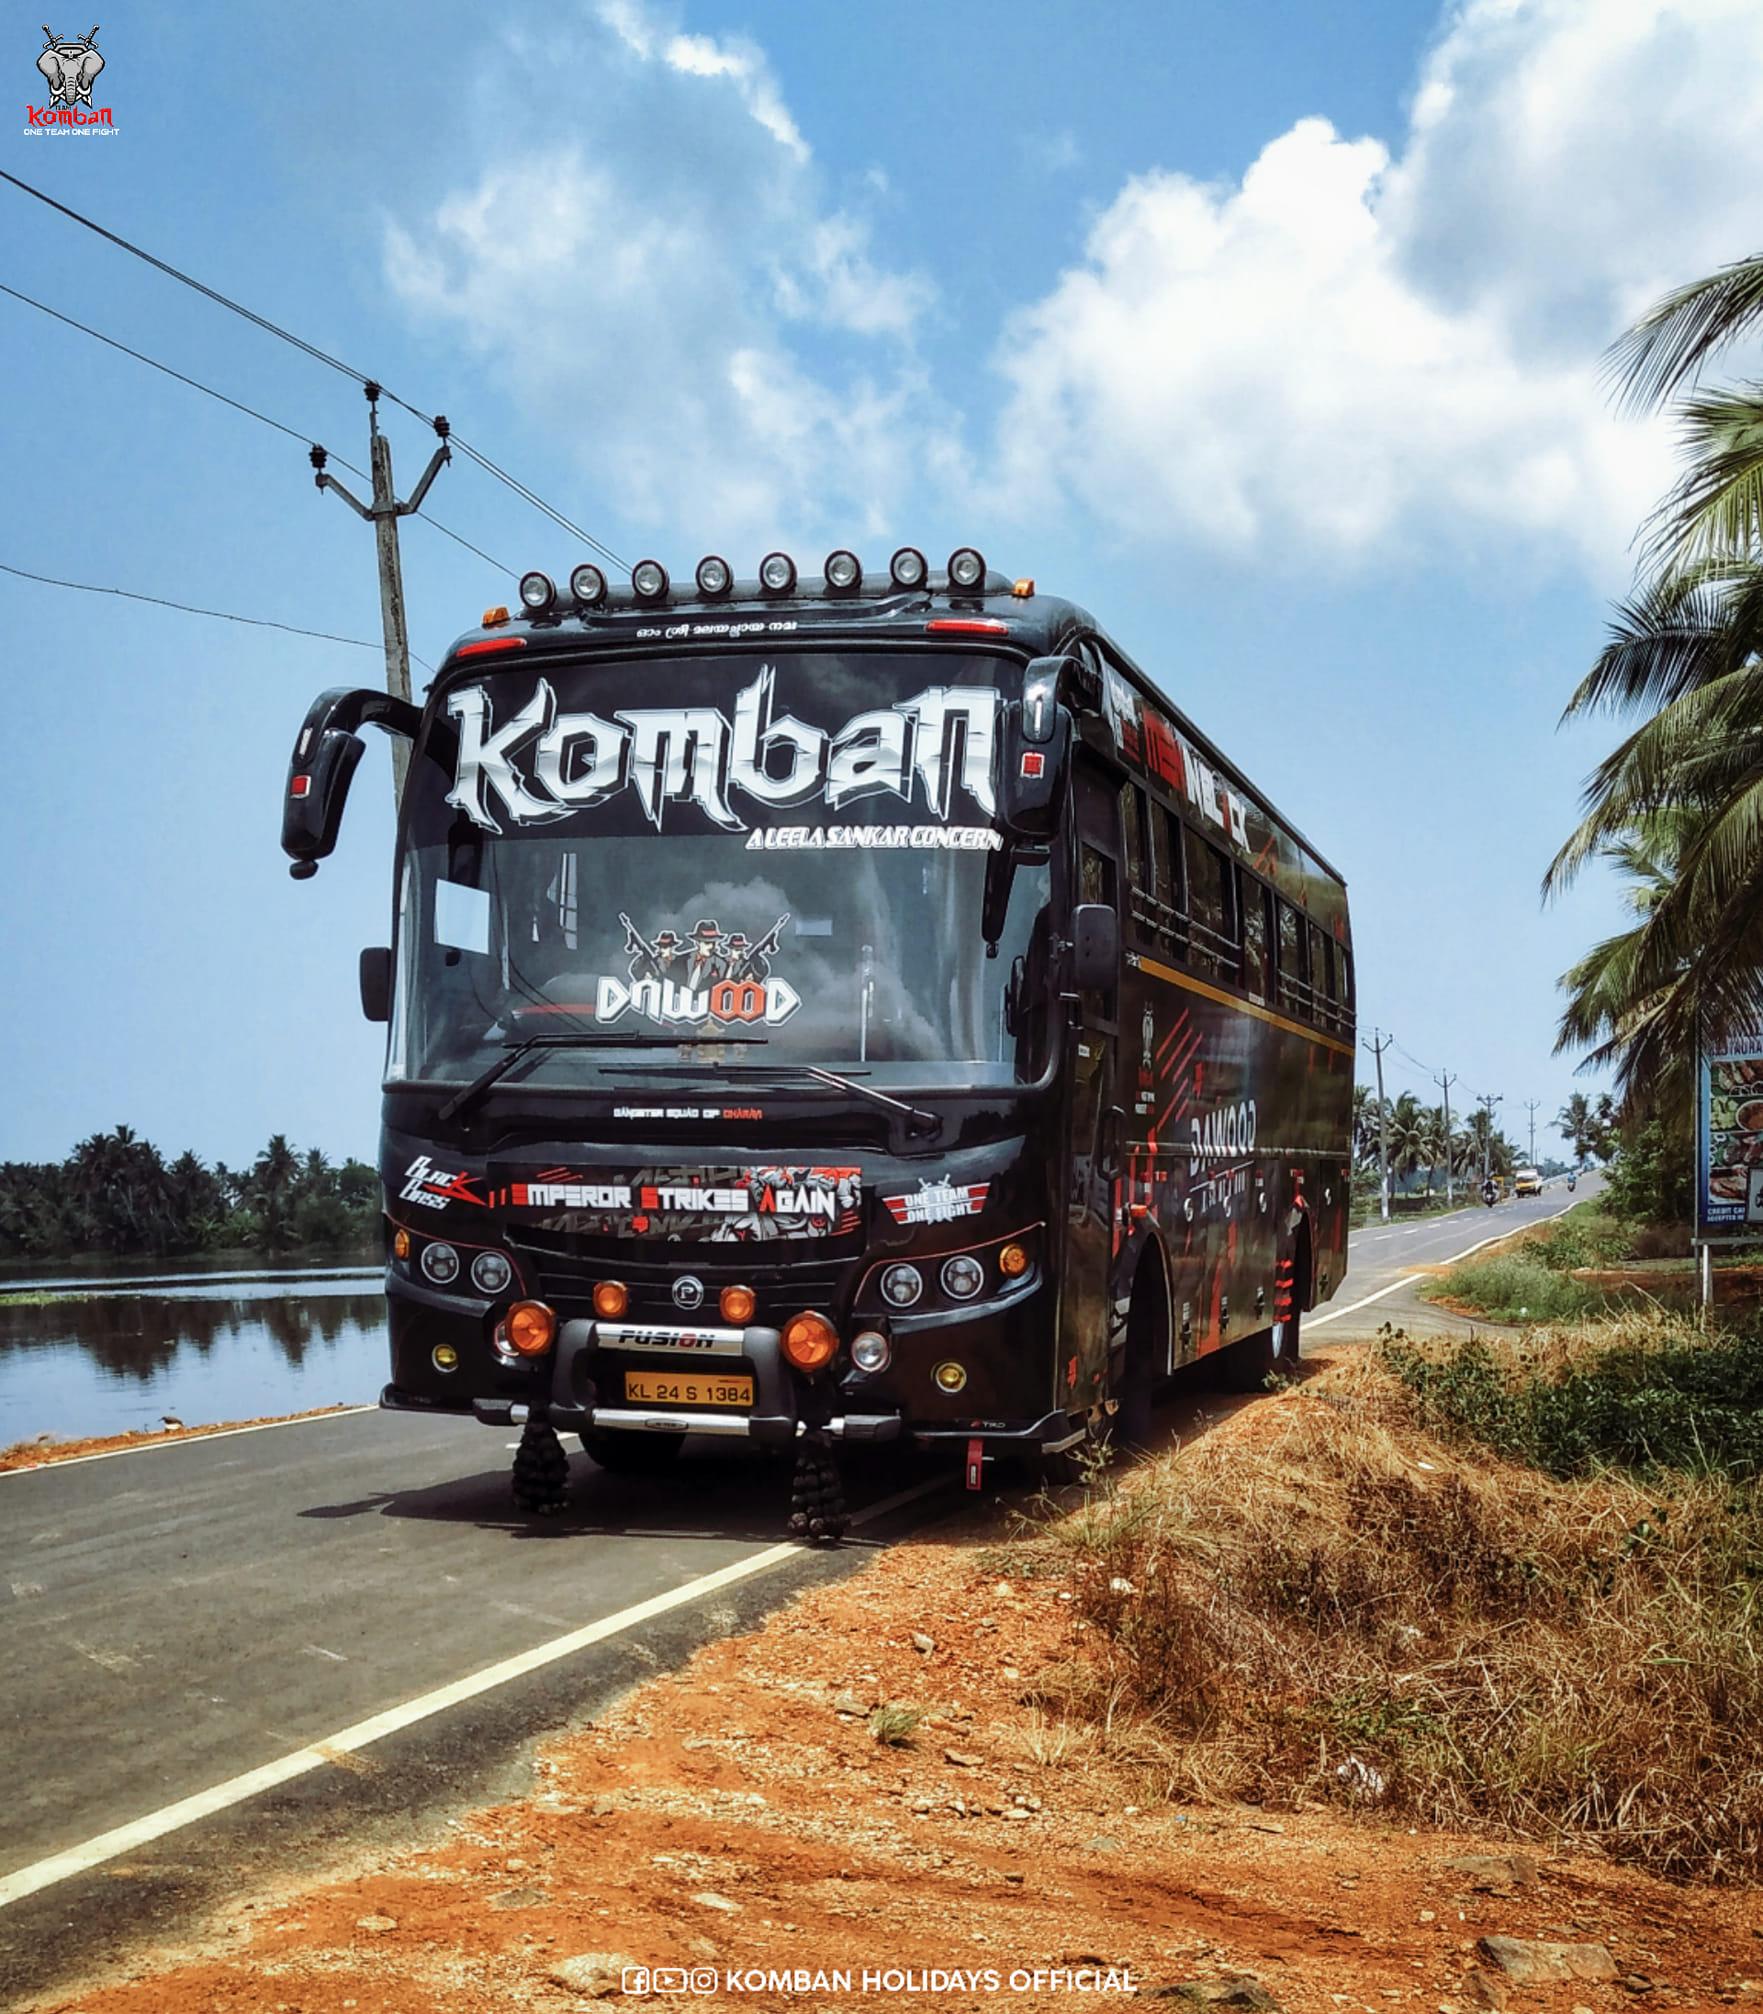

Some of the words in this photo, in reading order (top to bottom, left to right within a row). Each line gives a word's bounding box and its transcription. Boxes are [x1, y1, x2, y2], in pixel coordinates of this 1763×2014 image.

[764, 827, 825, 850] LEELA
[825, 826, 911, 850] SANKAR
[908, 827, 1004, 851] CONCERN
[665, 1107, 699, 1119] SQUAD
[702, 1108, 721, 1118] OF
[640, 1186, 749, 1212] STRIKES
[759, 1184, 836, 1222] AGAIN
[904, 1192, 929, 1207] ONE
[934, 1186, 969, 1203] TEAM
[906, 1209, 932, 1223] ONE
[935, 1202, 973, 1222] FIGHT
[618, 1330, 716, 1348] FUSION
[628, 1384, 651, 1399] KL
[656, 1385, 680, 1400] 24
[686, 1386, 698, 1400] S
[707, 1387, 751, 1402] 1384
